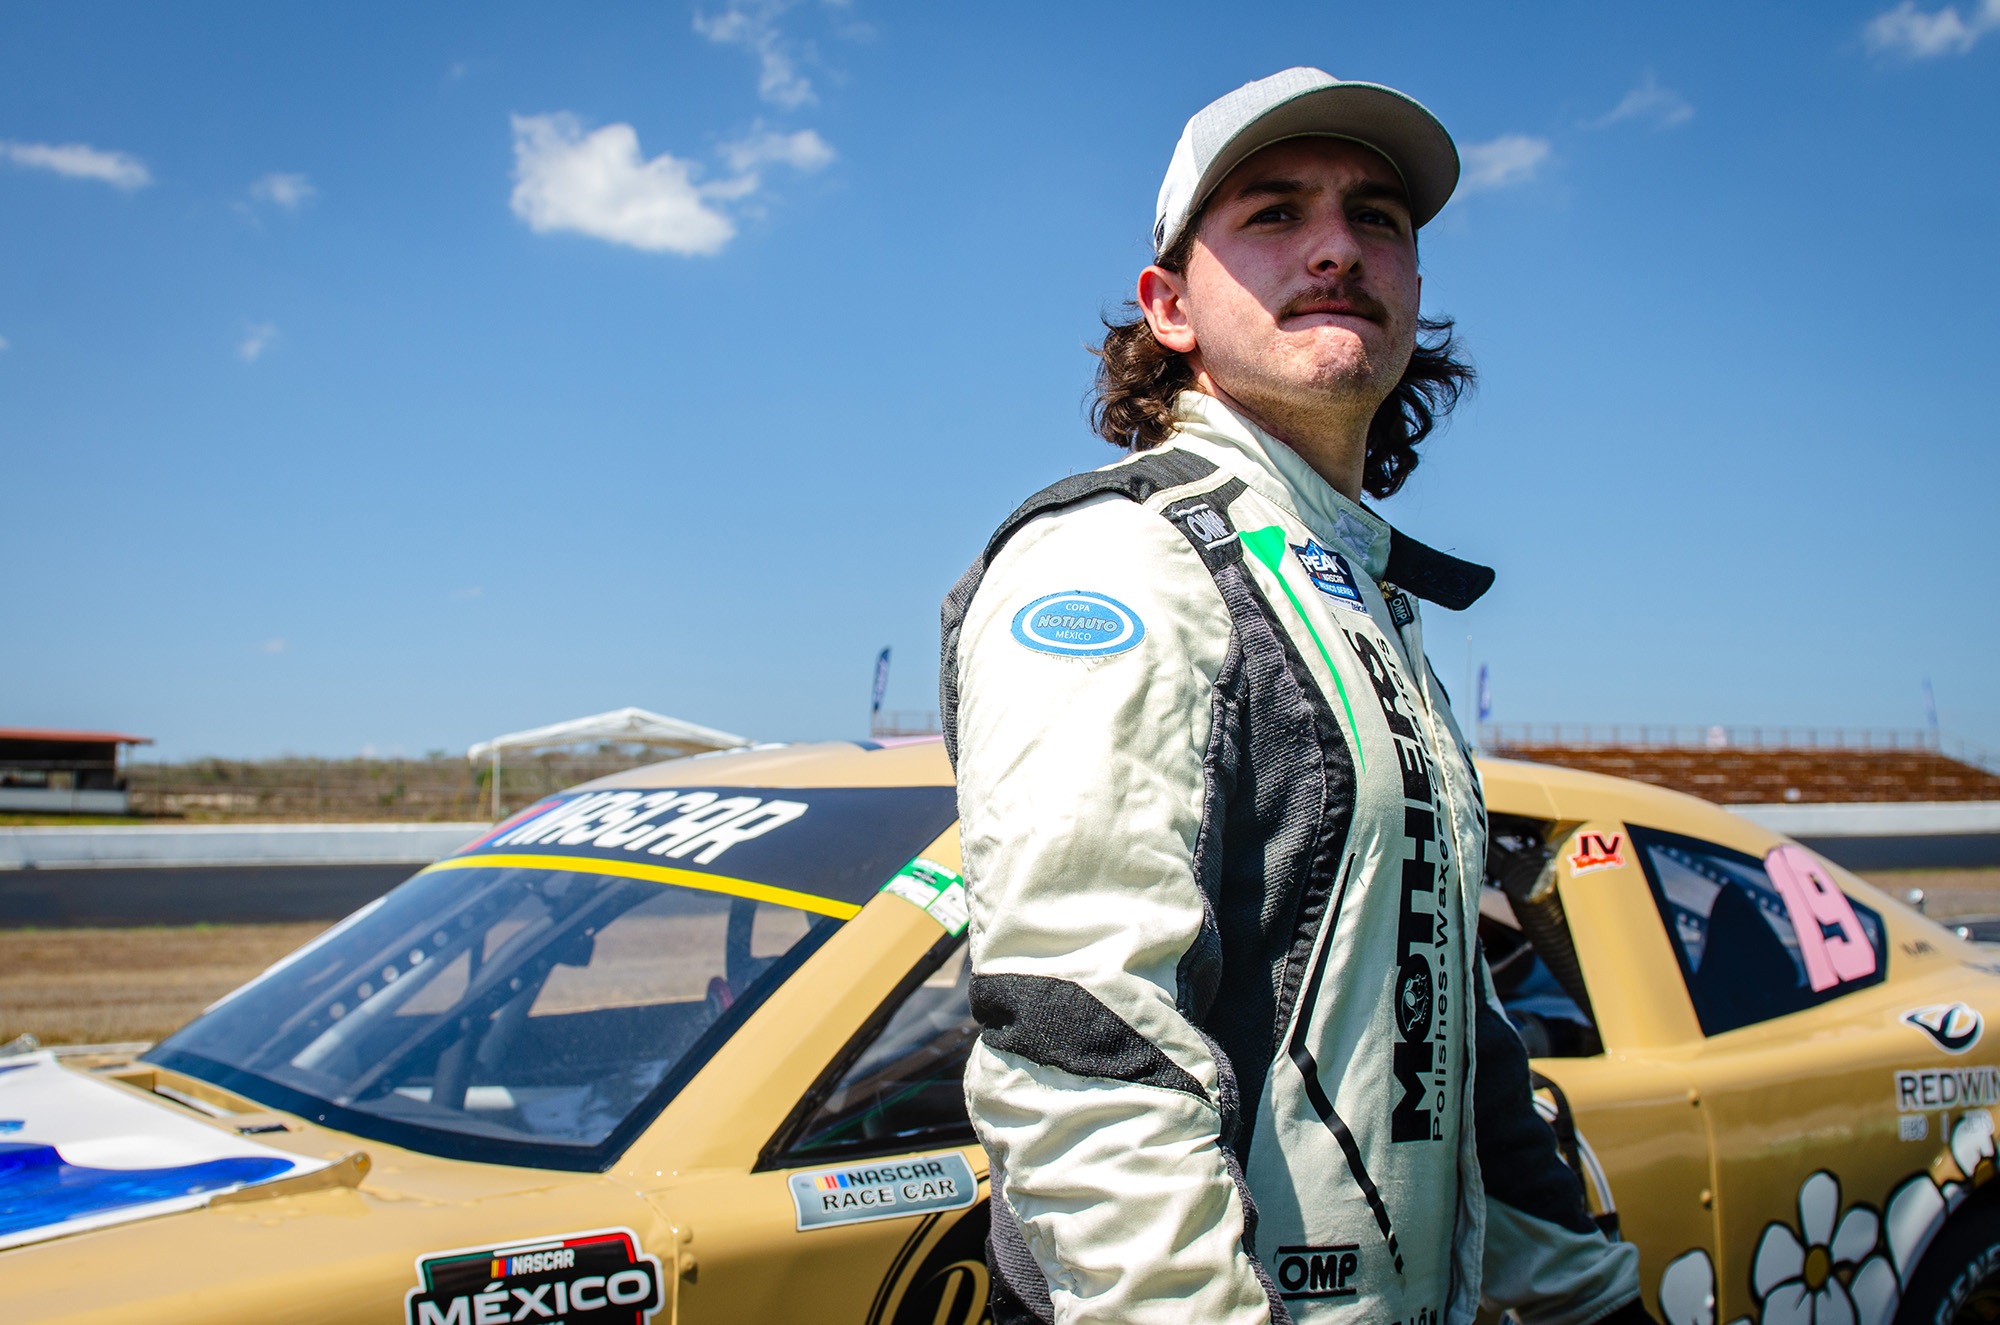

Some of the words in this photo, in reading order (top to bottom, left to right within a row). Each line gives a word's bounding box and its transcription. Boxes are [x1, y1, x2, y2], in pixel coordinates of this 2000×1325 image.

[1186, 510, 1230, 543] OMP
[1297, 553, 1348, 576] PEAK
[1066, 603, 1091, 613] COPA
[1392, 598, 1408, 619] OMP
[1037, 614, 1119, 633] NOTIAUTO
[1055, 629, 1092, 641] MÉXICO
[493, 791, 809, 865] NASCAR
[1340, 627, 1436, 1144] MOTHERS
[1764, 844, 1876, 992] 19
[847, 1161, 946, 1188] NASCAR
[821, 1187, 895, 1211] RACE
[902, 1178, 957, 1201] CAR
[511, 1248, 576, 1276] NASCAR
[1278, 1252, 1358, 1292] OMP
[417, 1269, 651, 1325] MÉXICO
